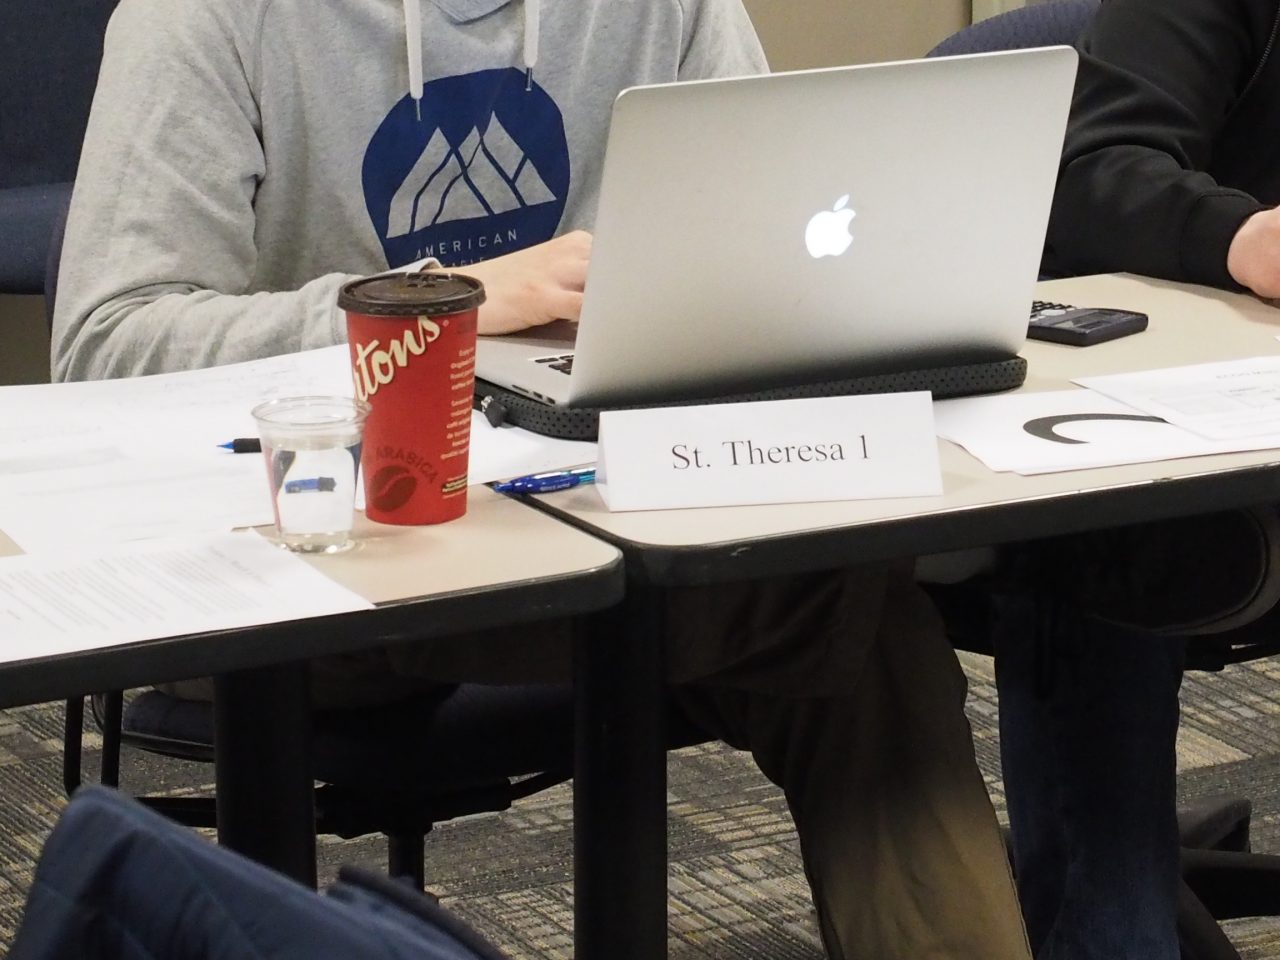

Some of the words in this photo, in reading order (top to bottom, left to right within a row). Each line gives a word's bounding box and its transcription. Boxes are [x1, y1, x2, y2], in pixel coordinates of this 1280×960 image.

[415, 228, 517, 260] AMERICAN
[671, 443, 712, 470] St.
[721, 440, 846, 466] Theresa
